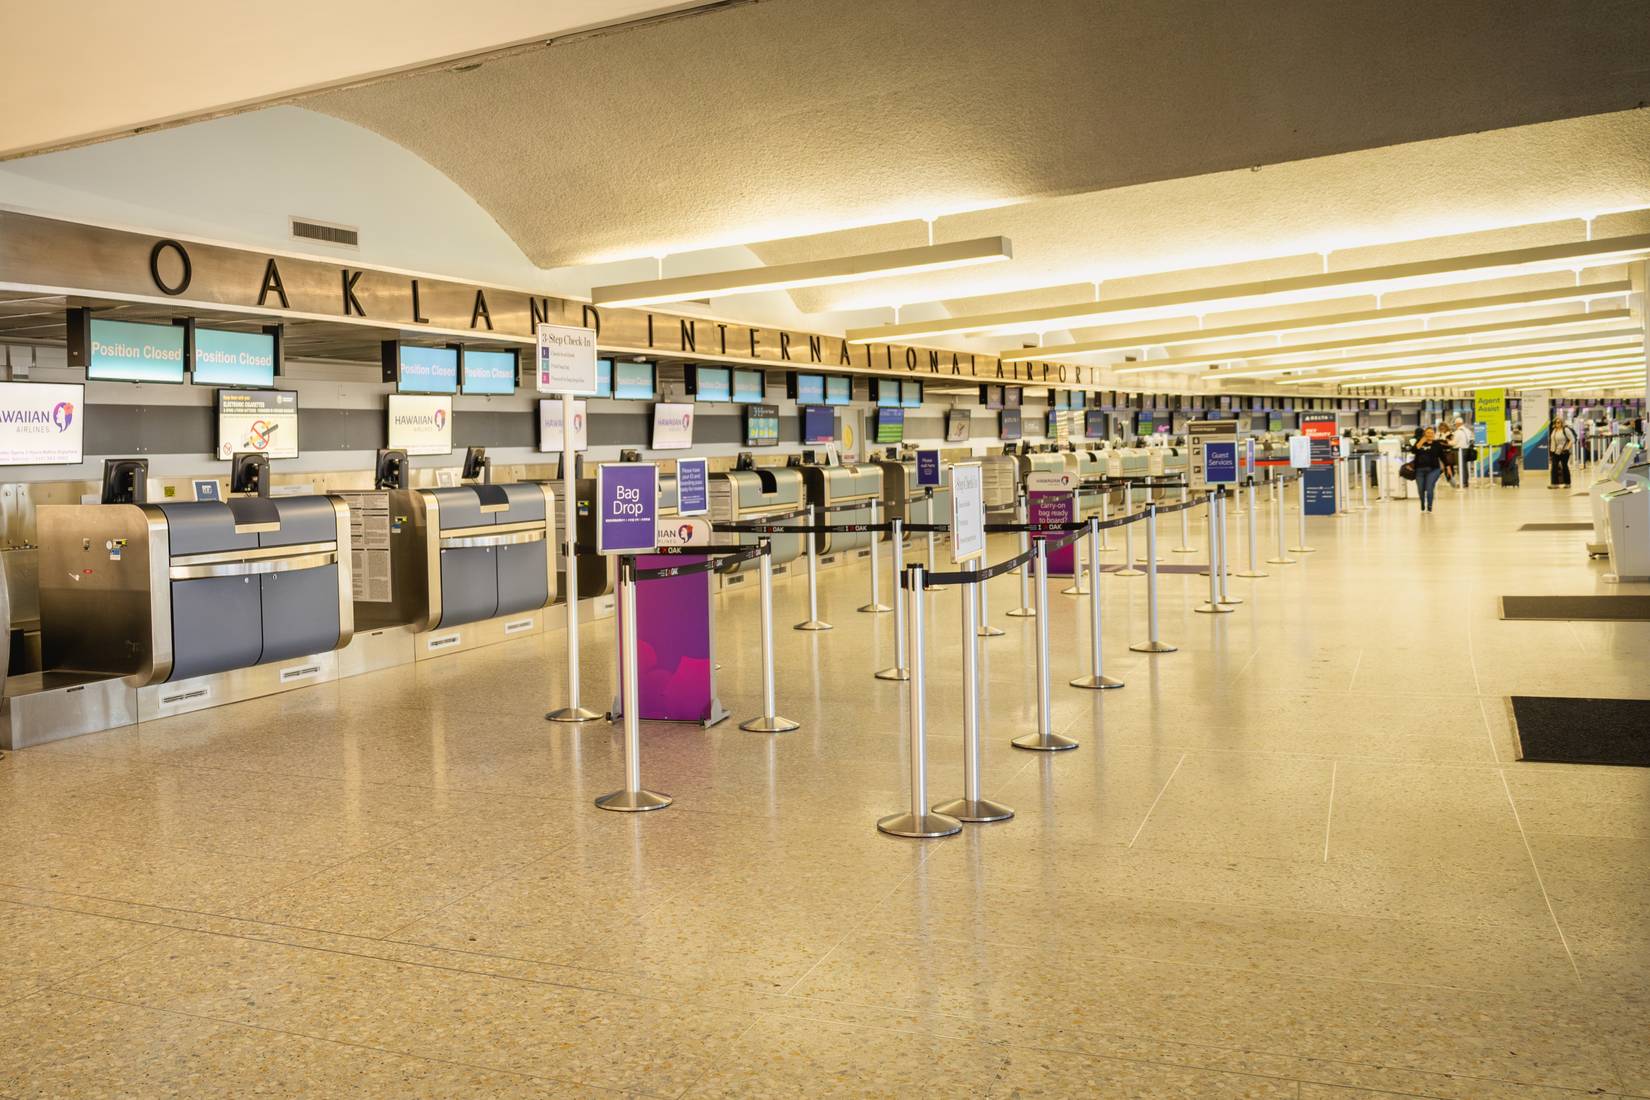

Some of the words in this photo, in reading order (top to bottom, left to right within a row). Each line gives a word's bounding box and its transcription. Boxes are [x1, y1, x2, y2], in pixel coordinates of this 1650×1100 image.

[150, 239, 601, 340] OAKLAND
[648, 314, 977, 376] INTERNATIONAL
[995, 358, 1094, 384] AIRPORT
[92, 342, 140, 358] Position
[143, 345, 182, 361] Closed
[195, 350, 236, 364] Position
[239, 352, 272, 367] Closed
[401, 363, 430, 375] Position
[431, 364, 456, 377] Closed
[1478, 398, 1500, 406] Agent
[0, 410, 50, 423] WAIIAN
[395, 416, 432, 425] HAWAIIAN
[616, 485, 639, 502] Bag
[613, 501, 643, 517] Drop
[658, 529, 676, 538] IIAN
